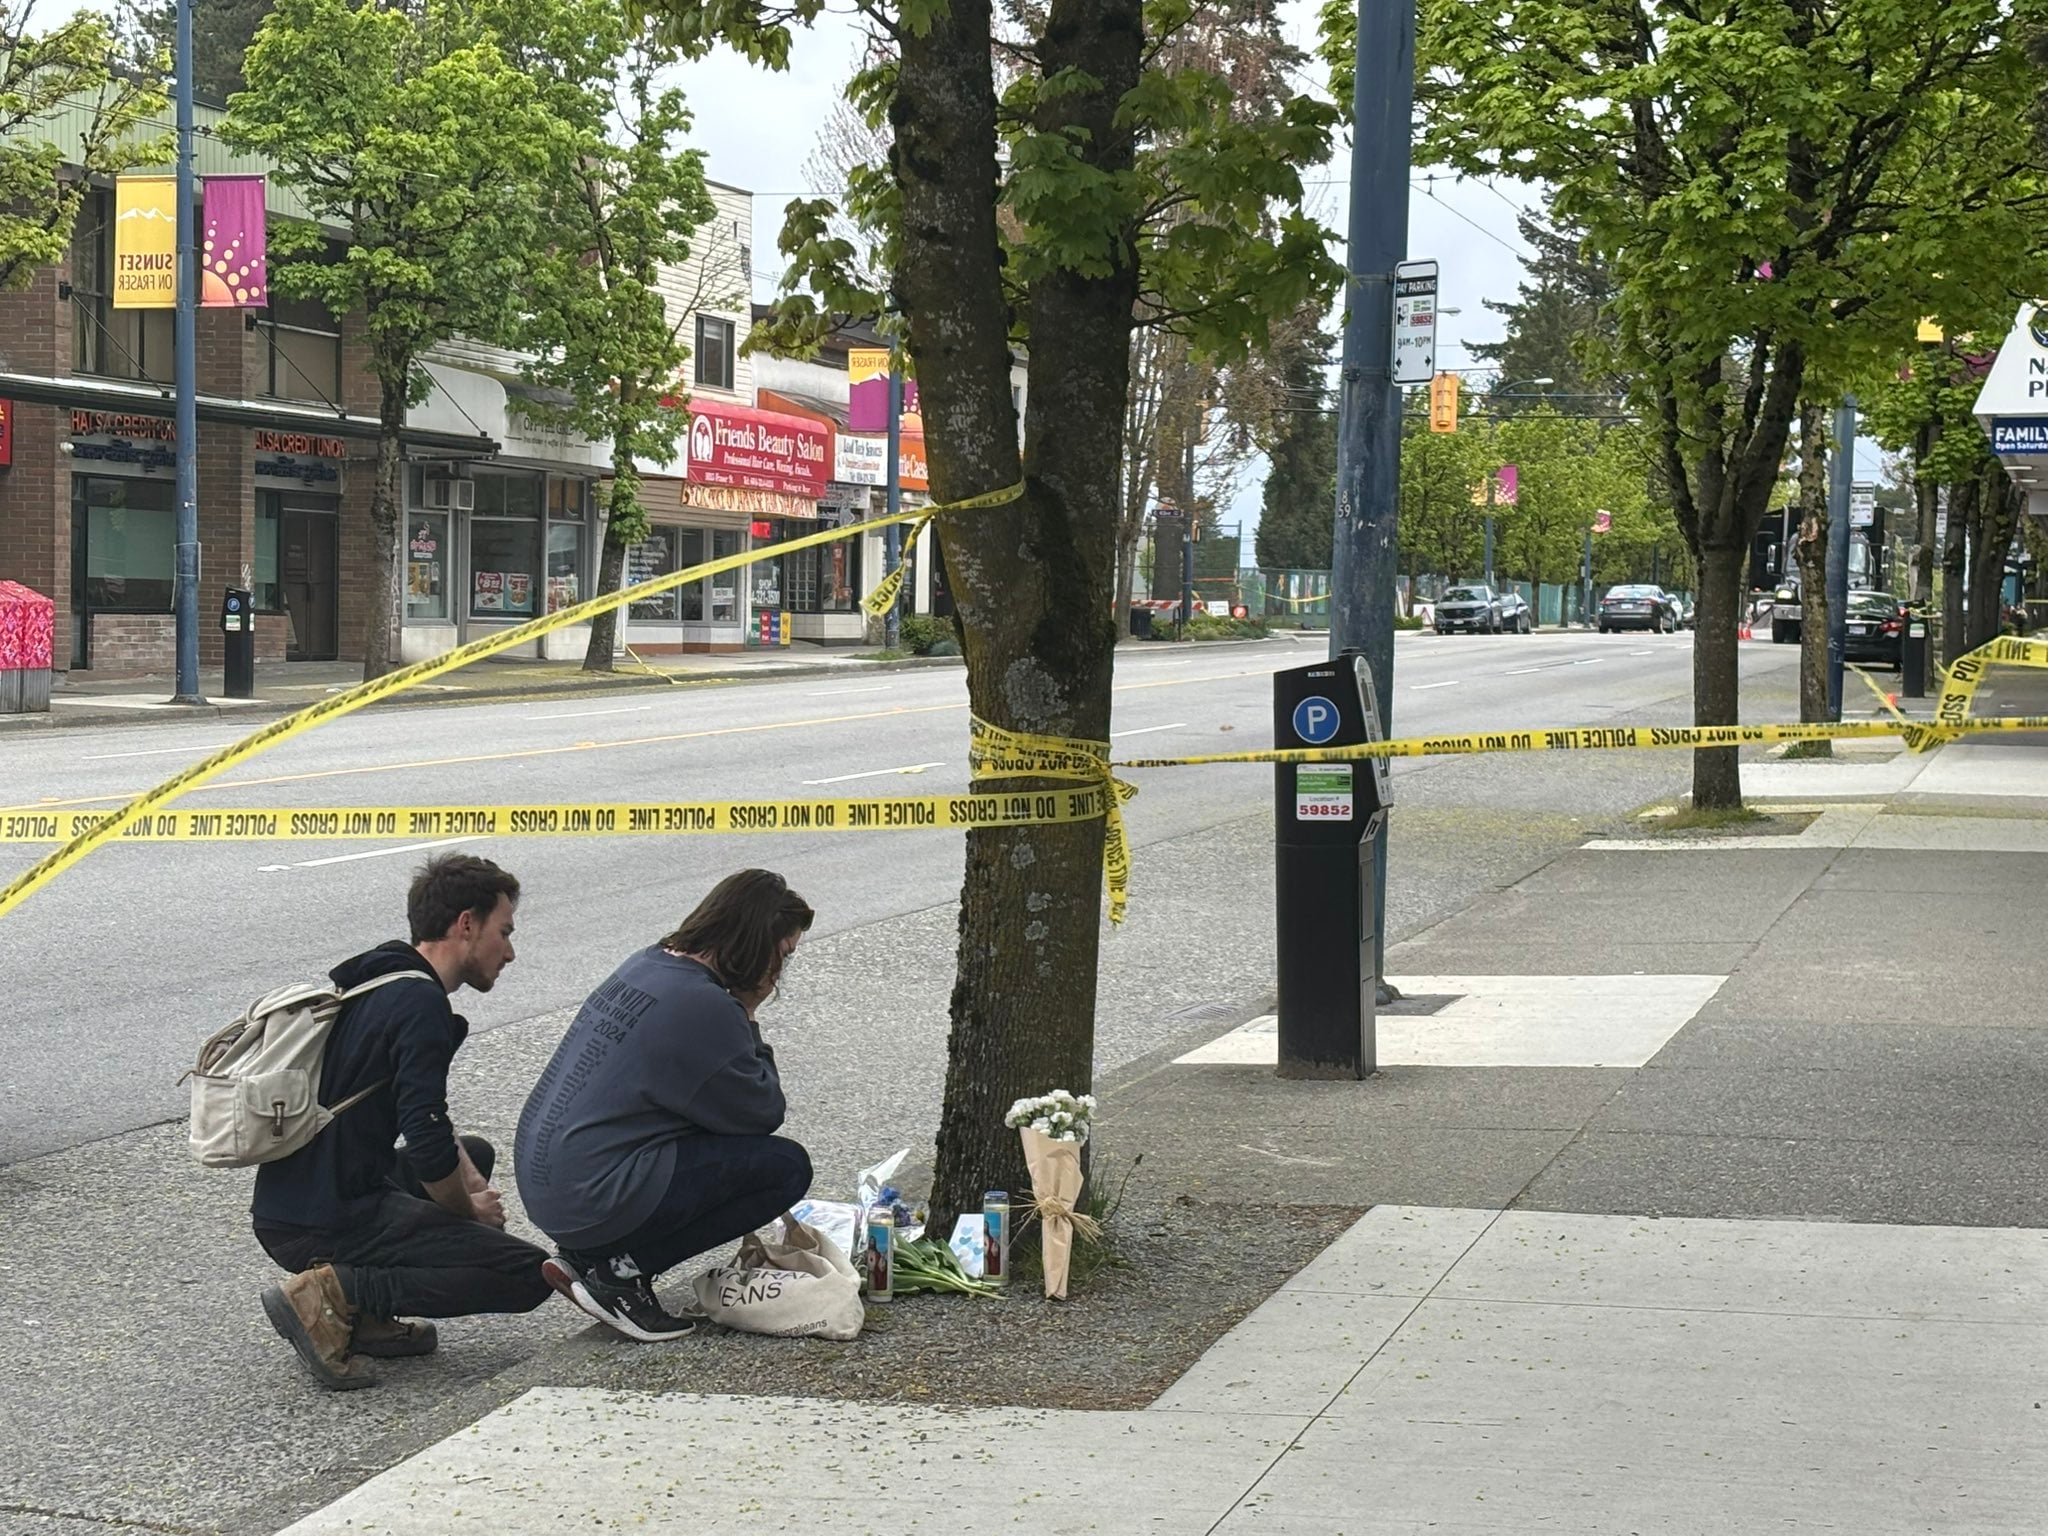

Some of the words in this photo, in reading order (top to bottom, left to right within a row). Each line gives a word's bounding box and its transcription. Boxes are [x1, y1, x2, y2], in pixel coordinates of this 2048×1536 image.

[1408, 279, 1437, 293] PARKING
[71, 410, 112, 434] HALSA
[281, 433, 315, 455] CREDIT
[317, 437, 345, 458] UNION
[714, 418, 755, 450] Friends
[758, 425, 795, 463] Beauty
[797, 433, 824, 462] Salon
[1995, 442, 2015, 451] Open
[2017, 442, 2048, 450] Saturda
[1341, 490, 1349, 504] 8
[1338, 504, 1351, 518] 59
[1307, 705, 1328, 735] P
[1511, 734, 1531, 748] DO
[1546, 731, 1578, 749] LINE
[1584, 729, 1636, 748] POLICE
[884, 802, 935, 824] POLICE
[950, 799, 997, 823] CROSS
[1002, 797, 1031, 820] NOT
[1036, 796, 1056, 818] DO
[1070, 790, 1094, 816] LINE
[1299, 805, 1350, 815] 59852
[290, 813, 338, 834] CROSS
[342, 813, 371, 834] NOT
[376, 813, 396, 833] DO
[409, 812, 440, 833] LINE
[445, 811, 496, 833] POLICE
[510, 810, 558, 832] CROSS
[562, 810, 591, 831] NOT
[595, 809, 615, 830] DO
[628, 809, 660, 830] LINE
[664, 808, 715, 829] POLICE
[729, 806, 777, 828] CROSS
[782, 805, 810, 827] NOT
[815, 805, 834, 826] DO
[848, 804, 880, 825] LINE
[6, 817, 58, 838] POLICE
[123, 816, 153, 836] NOT
[156, 815, 177, 836] DO
[189, 815, 221, 836] LINE
[225, 815, 276, 836] POLICE
[593, 1018, 628, 1046] 2024
